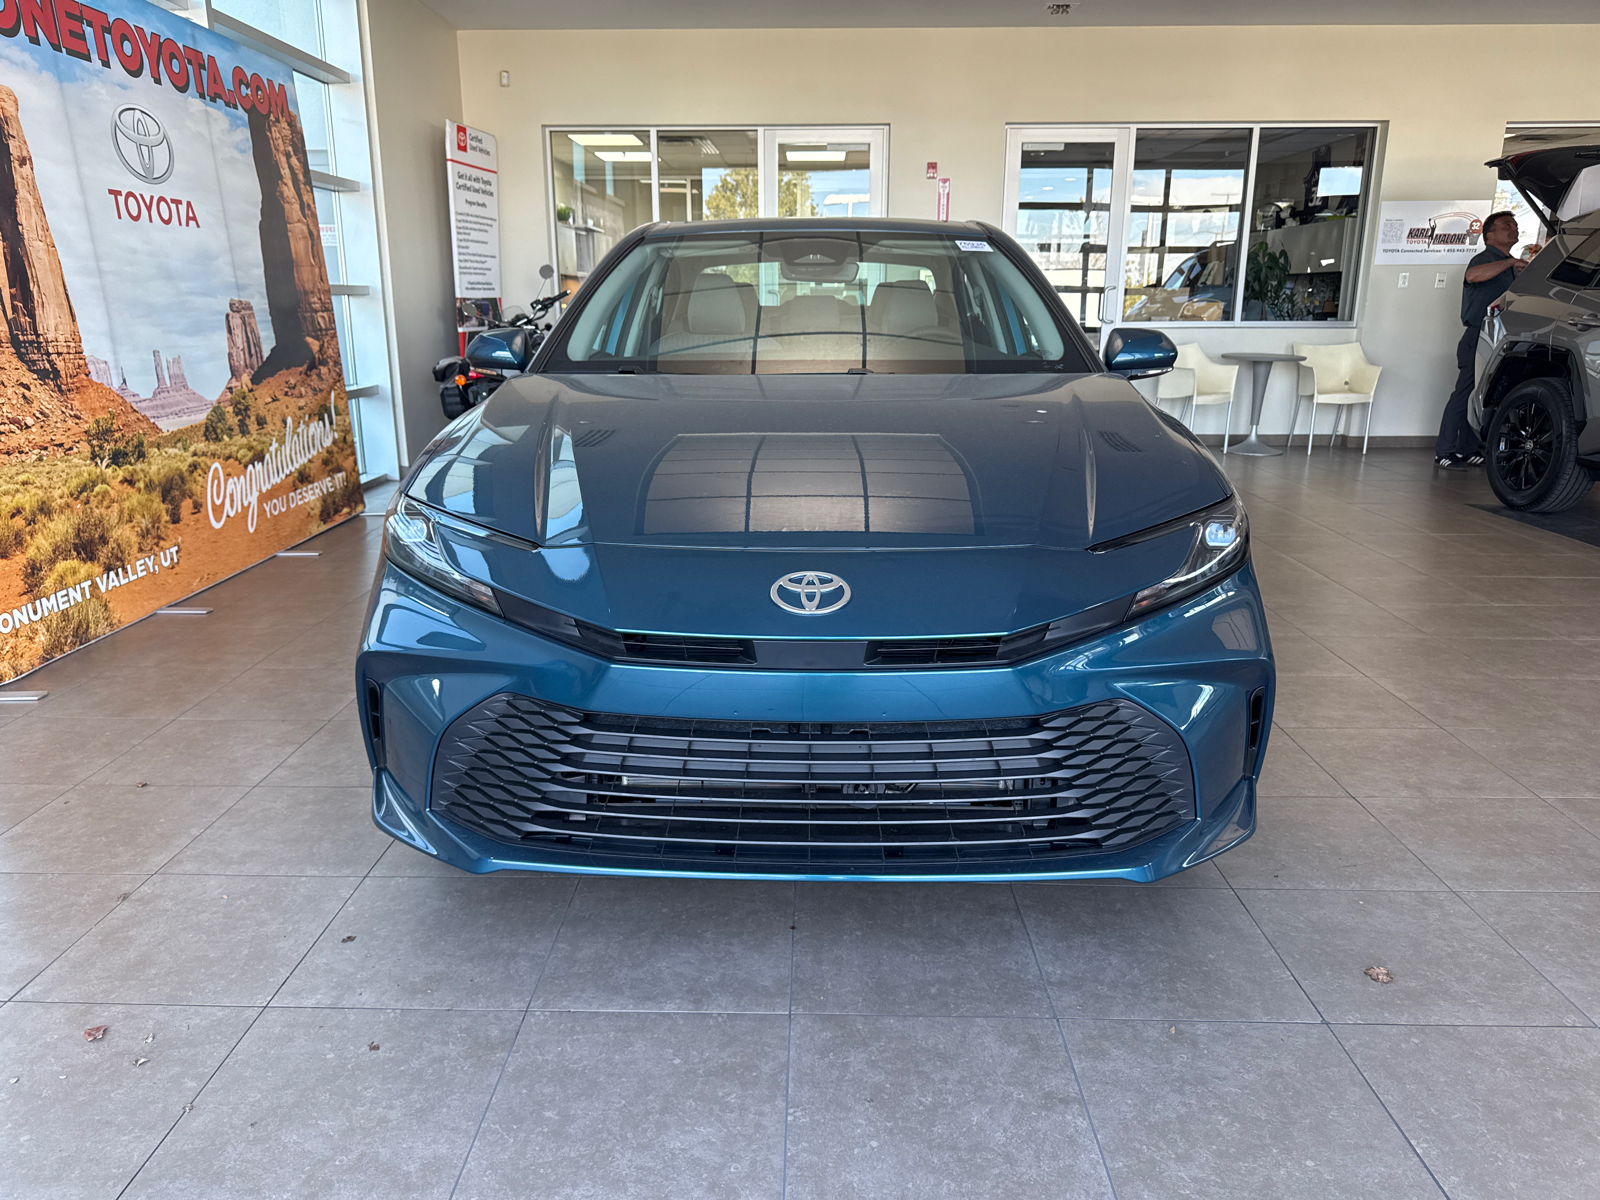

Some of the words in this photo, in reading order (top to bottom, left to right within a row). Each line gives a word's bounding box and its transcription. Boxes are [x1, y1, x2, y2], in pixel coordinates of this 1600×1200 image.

[481, 176, 492, 188] Toyota
[108, 188, 201, 228] TOYOTA
[1471, 222, 1480, 230] 32
[1407, 228, 1430, 239] KARL
[1432, 233, 1468, 244] MALONE
[207, 390, 338, 533] Congratulations!
[263, 495, 287, 519] YOU
[288, 475, 334, 509] DESERVE
[333, 471, 347, 490] IT!
[95, 555, 159, 594] VALLEY,
[160, 546, 179, 568] UT
